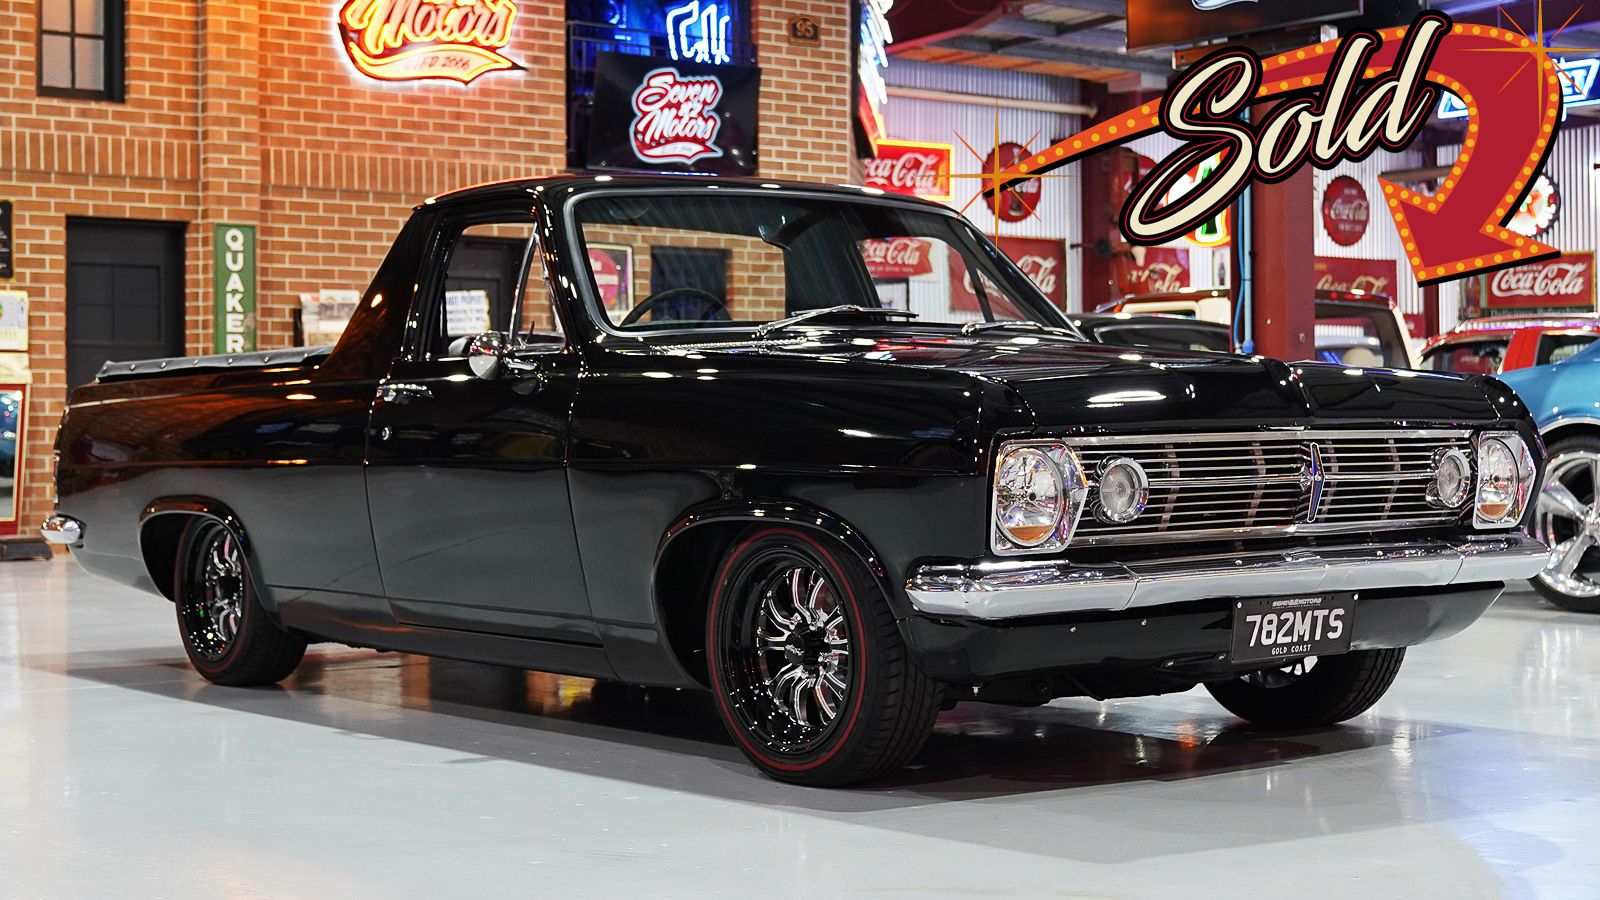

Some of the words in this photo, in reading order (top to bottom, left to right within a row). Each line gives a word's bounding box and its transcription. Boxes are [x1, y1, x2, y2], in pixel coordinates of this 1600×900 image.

[637, 74, 716, 113] Seven
[637, 109, 715, 145] Motors
[224, 228, 245, 353] QUAKER
[1246, 608, 1345, 647] 782MTS
[1272, 647, 1288, 655] GOLD
[1291, 644, 1312, 653] COAST
